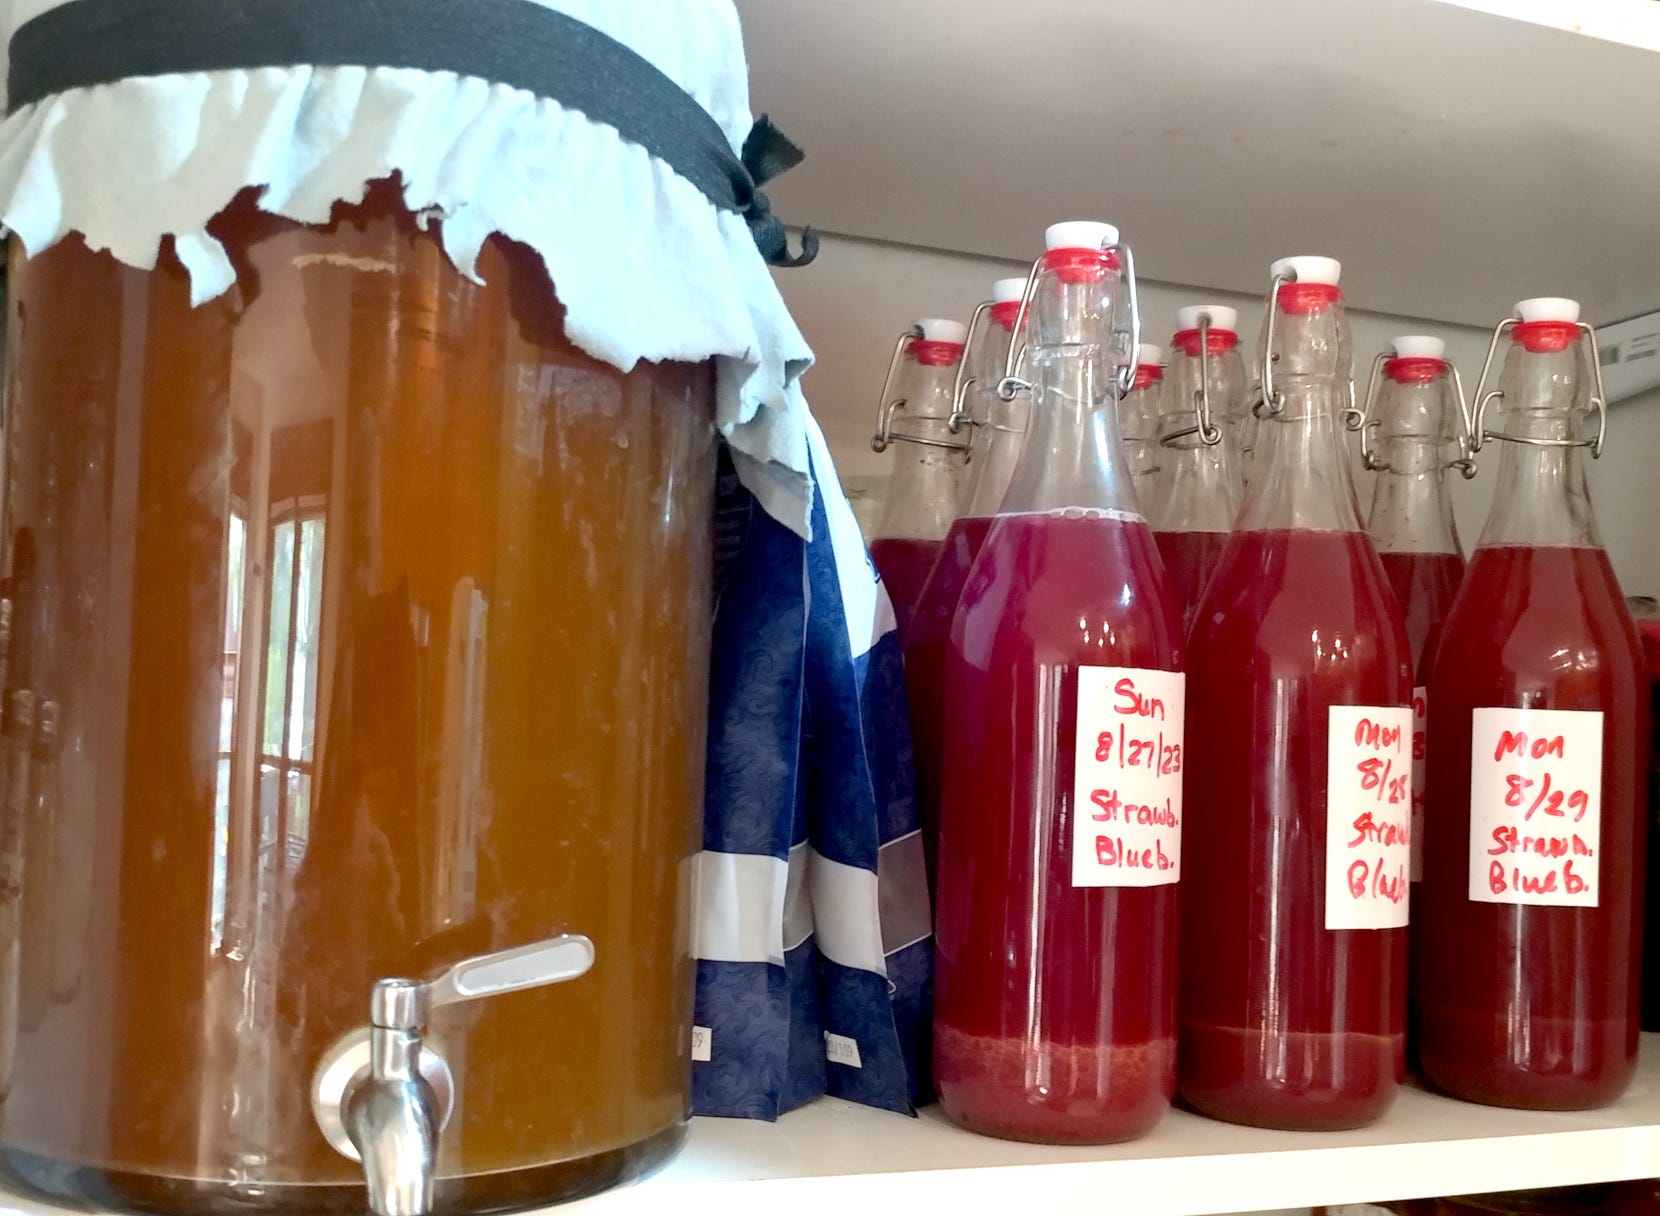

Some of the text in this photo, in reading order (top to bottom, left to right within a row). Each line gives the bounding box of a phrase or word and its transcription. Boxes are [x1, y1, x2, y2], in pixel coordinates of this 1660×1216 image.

[1114, 678, 1164, 721] Sun
[1095, 723, 1181, 778] 8/27/23
[1355, 718, 1400, 753] Mon
[1494, 730, 1564, 762] Mon
[1090, 789, 1179, 828] Strawb.
[1505, 773, 1588, 822] 8/29
[1095, 834, 1175, 870] Blueb.
[1489, 859, 1589, 894] Blueb.
